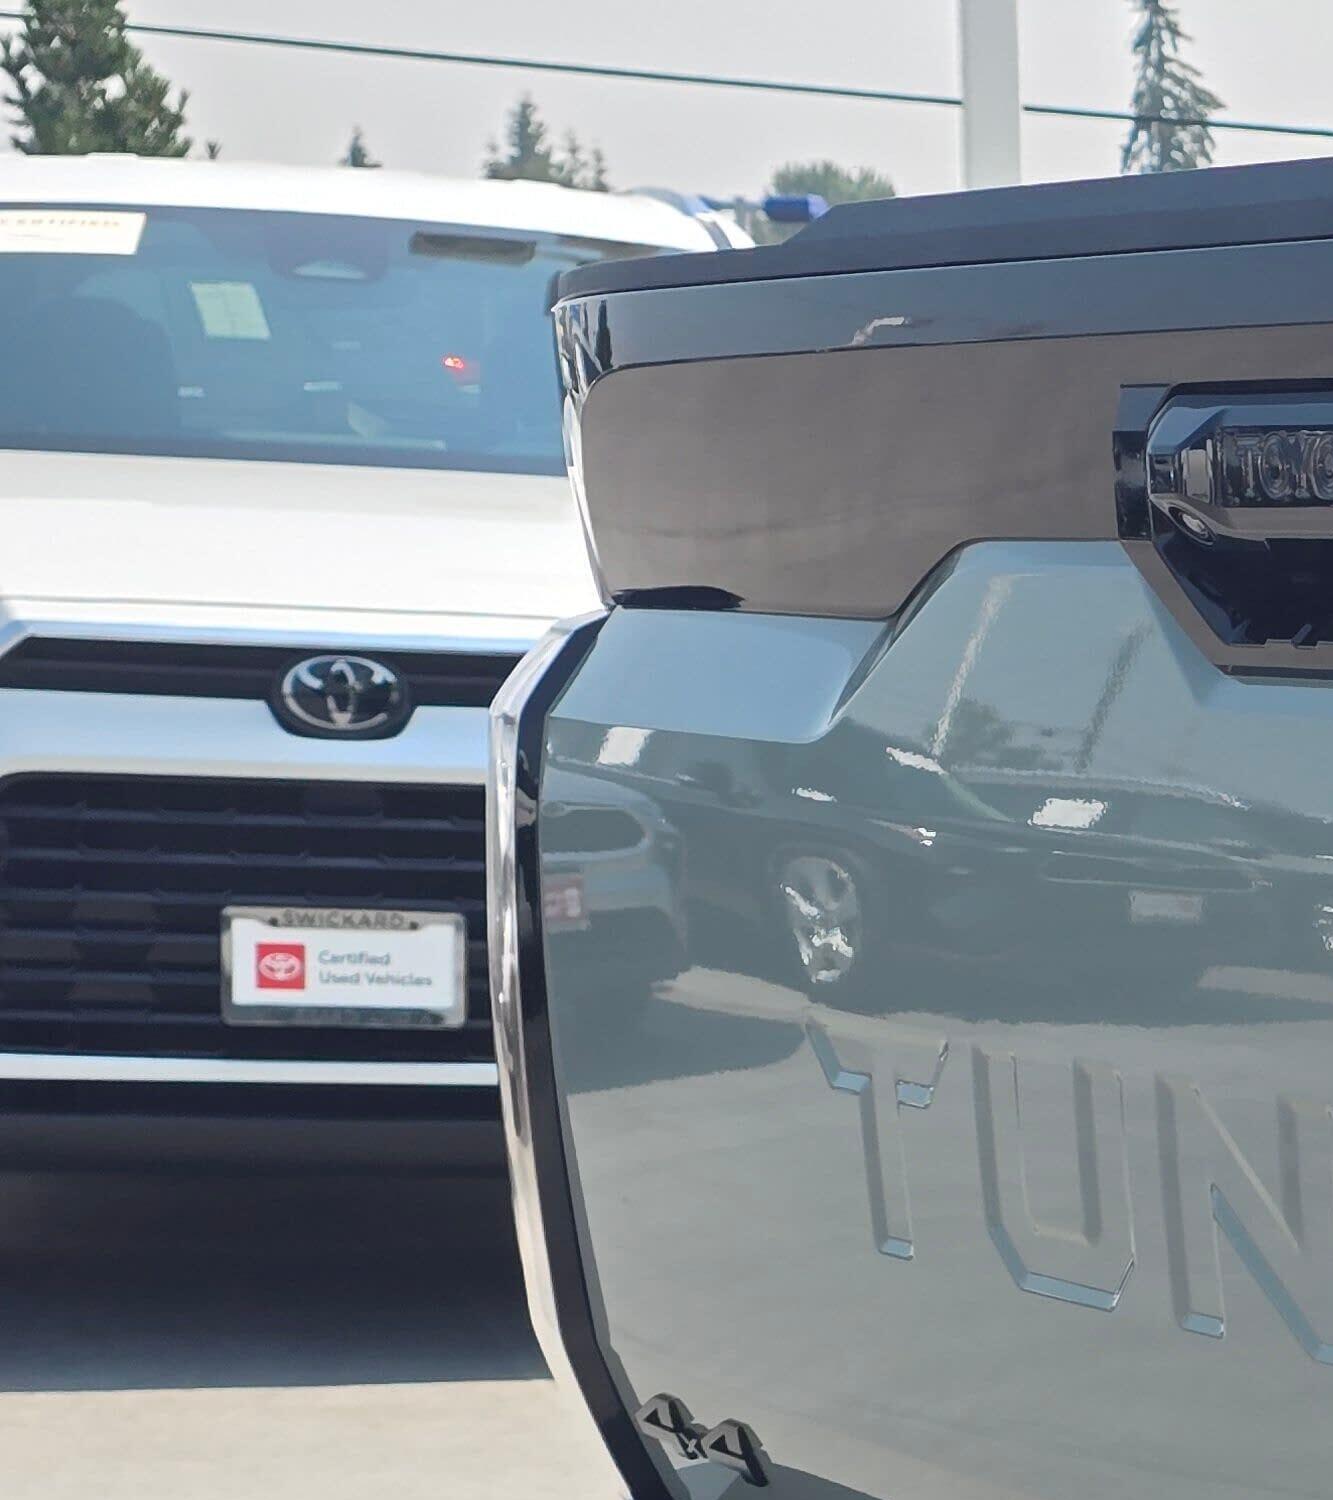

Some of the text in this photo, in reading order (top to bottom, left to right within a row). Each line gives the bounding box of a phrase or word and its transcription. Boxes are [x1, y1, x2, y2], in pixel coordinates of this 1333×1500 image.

[283, 910, 404, 929] SWICKARD
[318, 950, 390, 965] Certified
[319, 971, 432, 986] Used Vehicles
